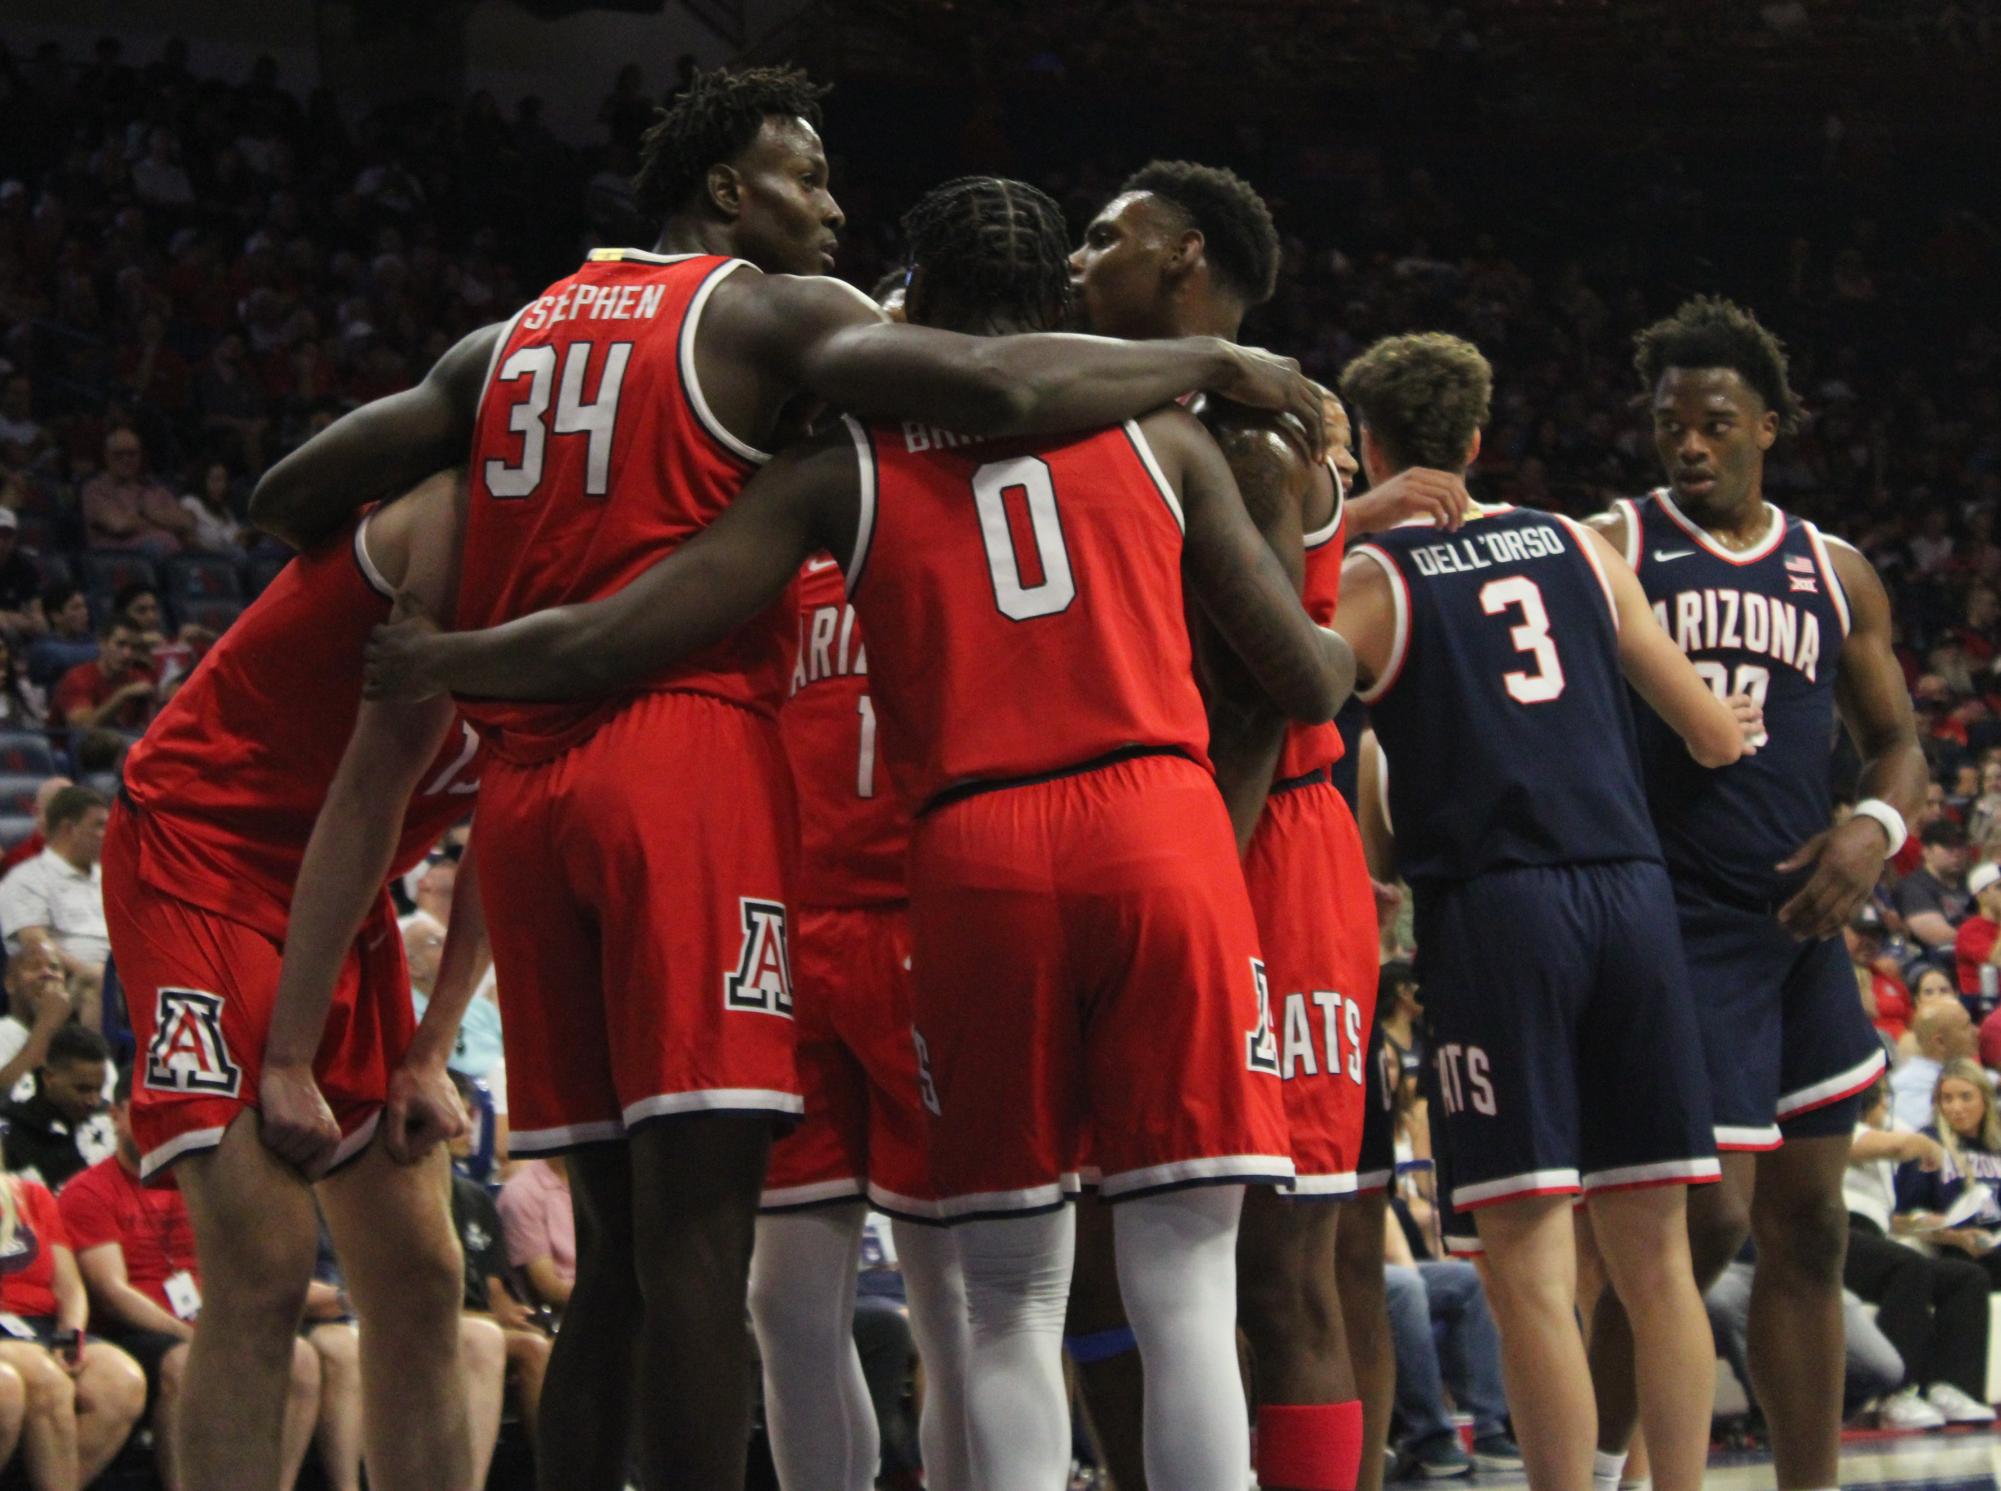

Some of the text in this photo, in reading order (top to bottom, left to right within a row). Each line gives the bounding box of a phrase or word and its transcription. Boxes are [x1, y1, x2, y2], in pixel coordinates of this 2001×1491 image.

[484, 340, 635, 499] 34
[971, 454, 1077, 624] 0
[1409, 525, 1567, 577] DELL'ORSO
[1478, 574, 1566, 705] 3
[143, 985, 244, 1100] A
